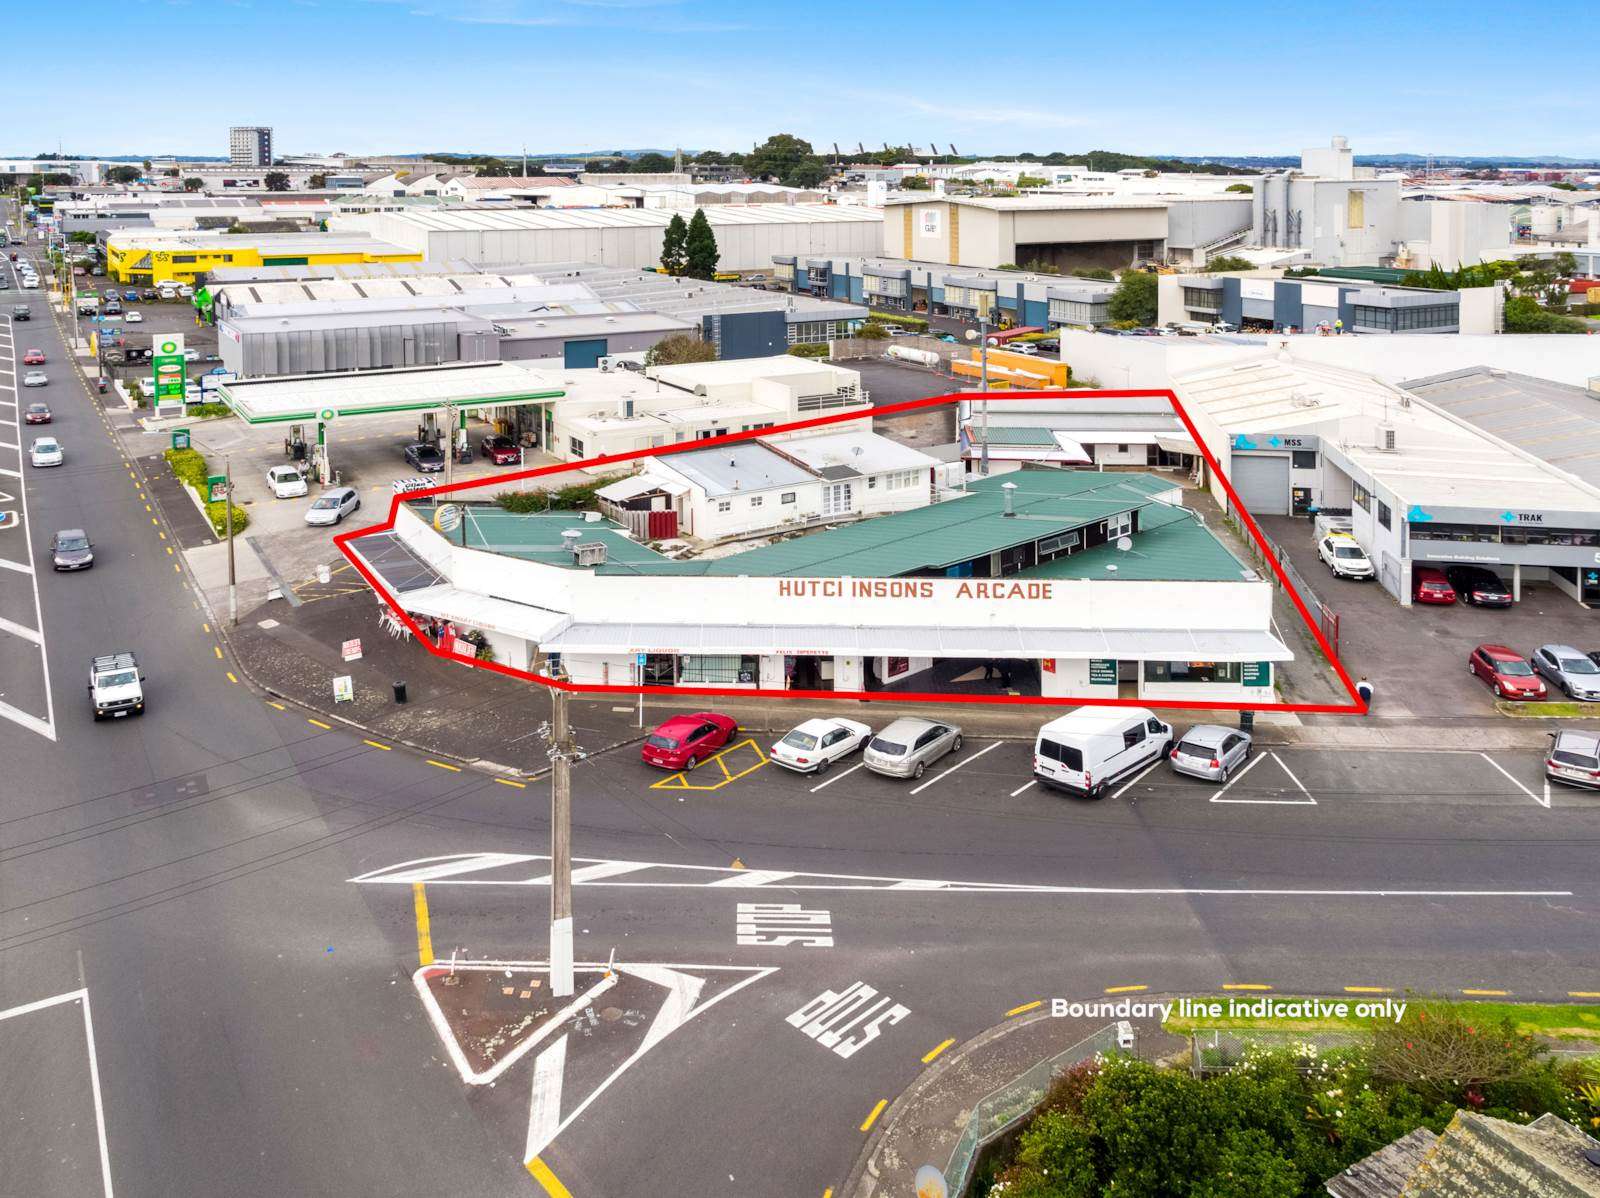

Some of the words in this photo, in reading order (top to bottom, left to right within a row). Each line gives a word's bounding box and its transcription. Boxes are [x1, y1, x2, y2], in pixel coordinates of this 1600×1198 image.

[1518, 513, 1543, 522] TRAK
[956, 582, 1053, 600] ARCADE
[736, 903, 834, 947] STOP
[785, 980, 912, 1059] STOP
